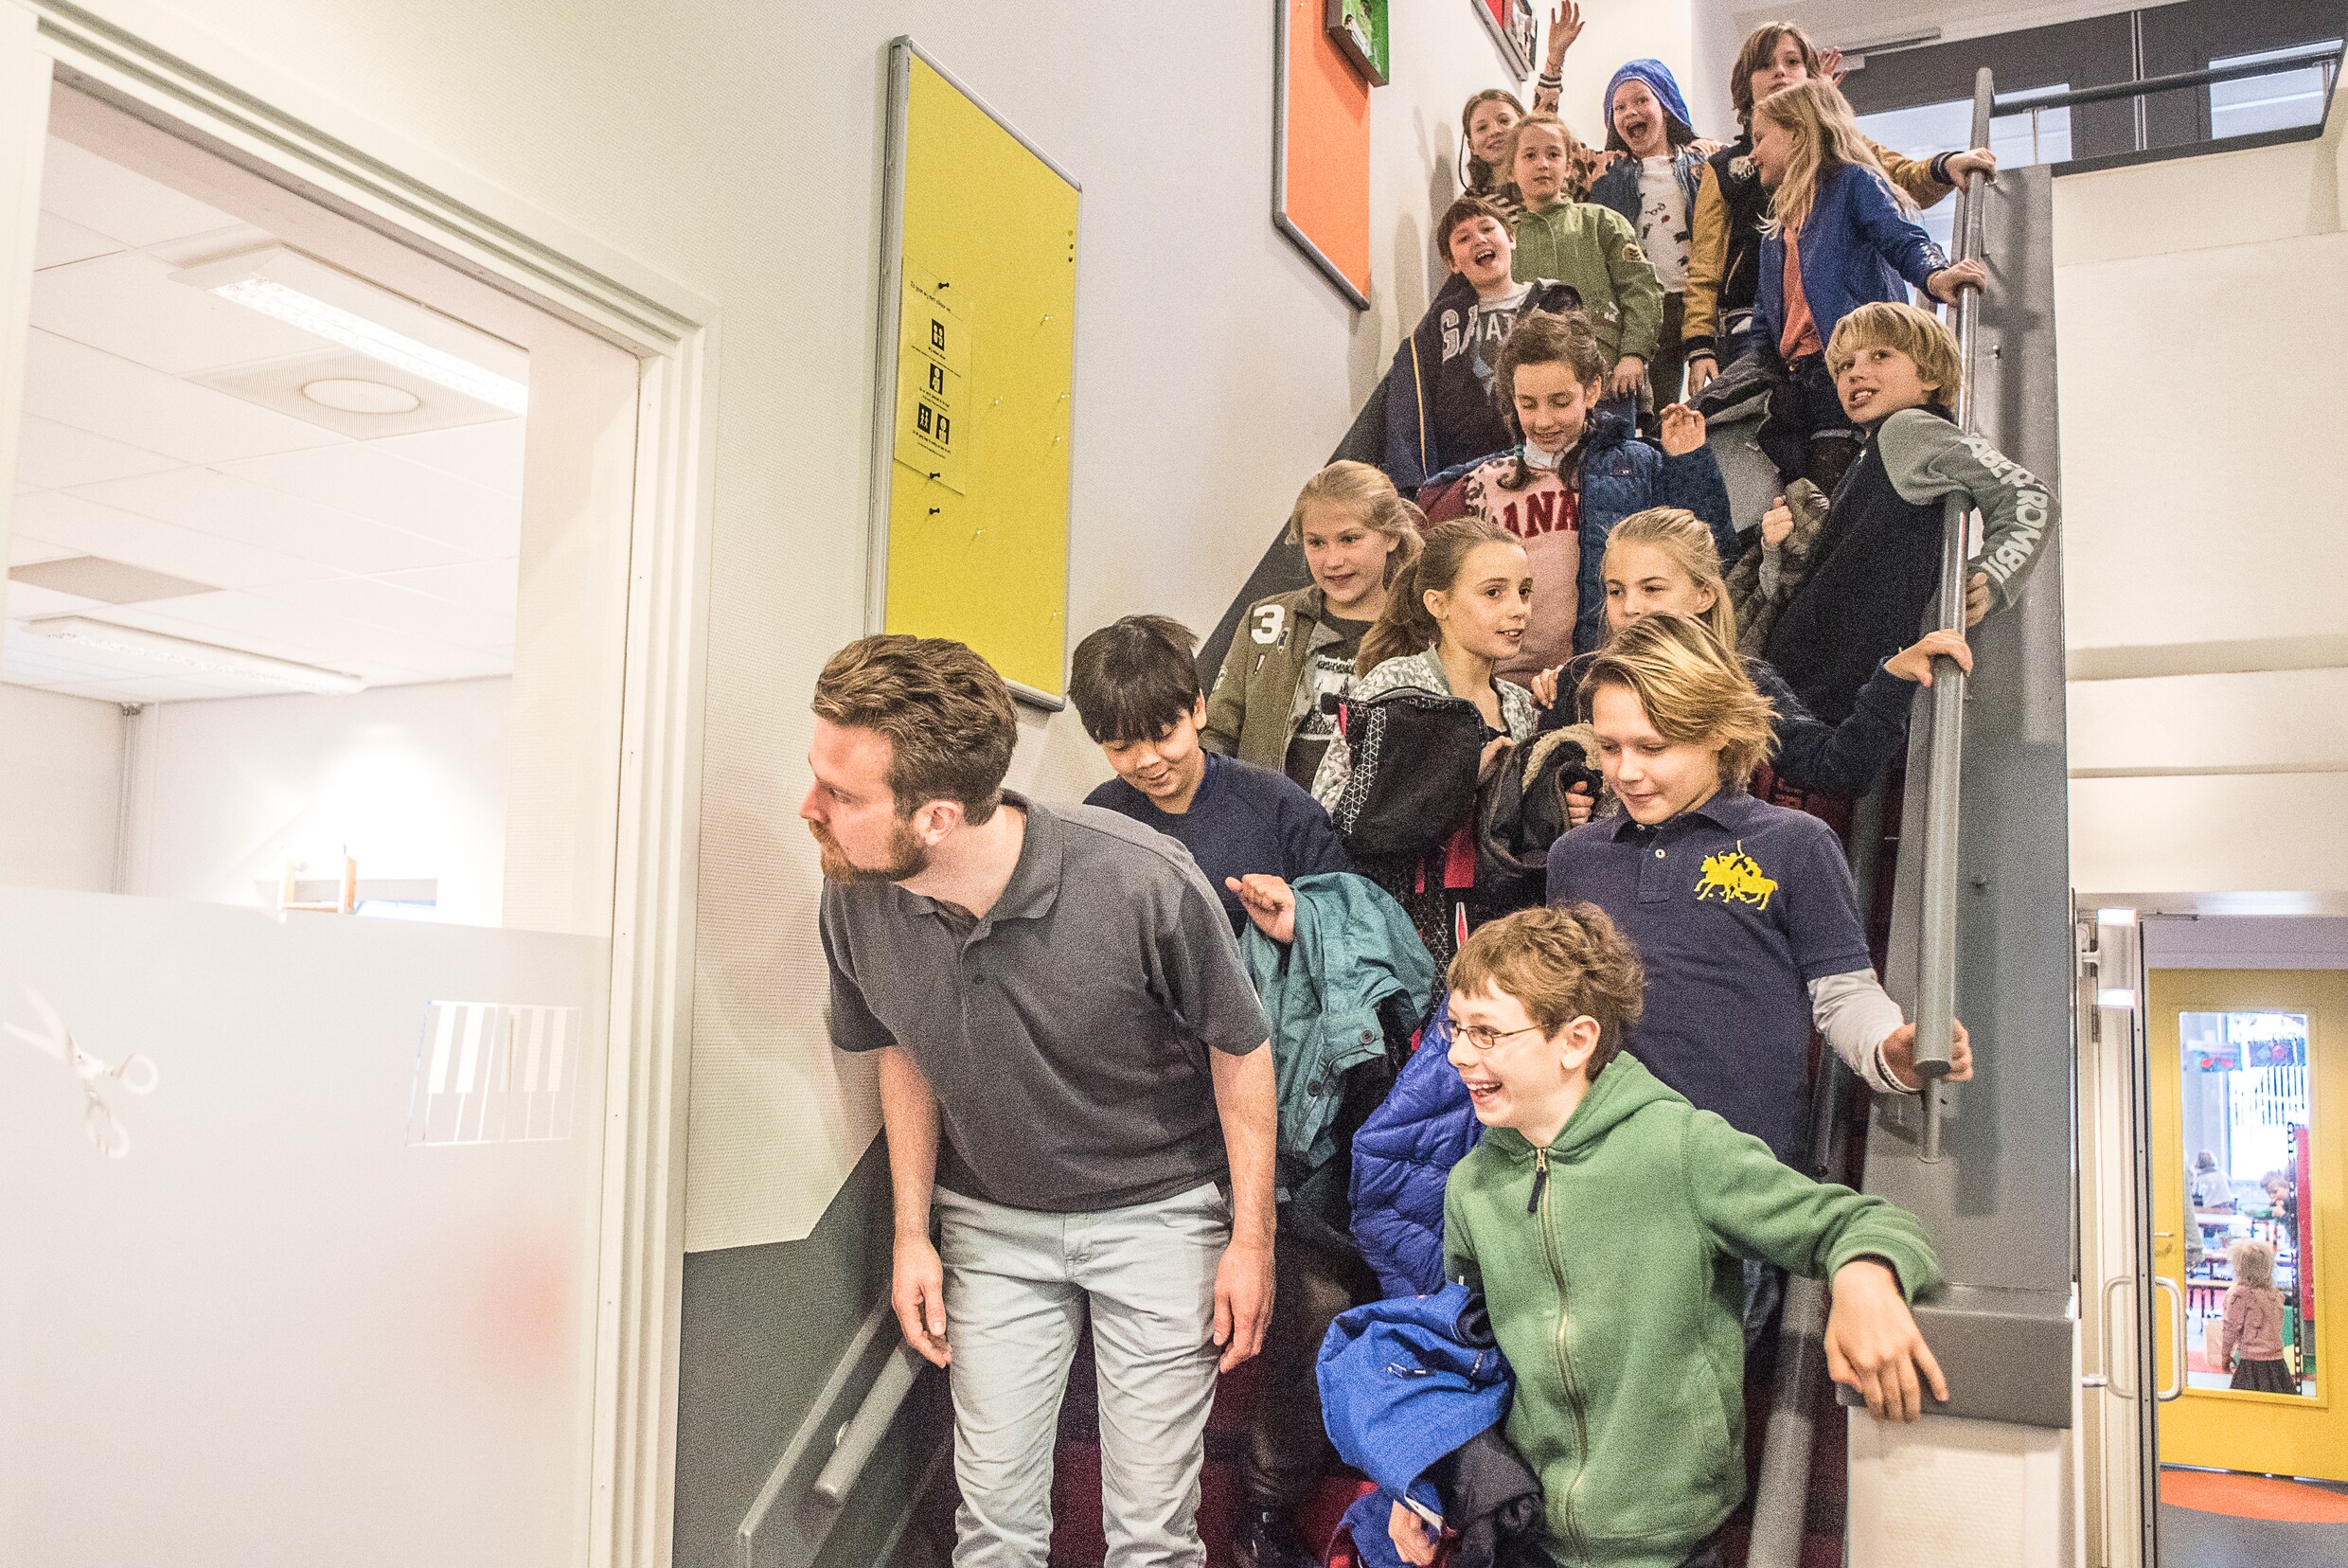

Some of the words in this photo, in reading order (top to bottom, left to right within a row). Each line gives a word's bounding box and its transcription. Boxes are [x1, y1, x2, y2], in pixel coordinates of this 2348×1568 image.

[1492, 490, 1579, 538] ANA
[1960, 433, 2048, 583] ABERROMBI
[1251, 604, 1285, 644] 3
